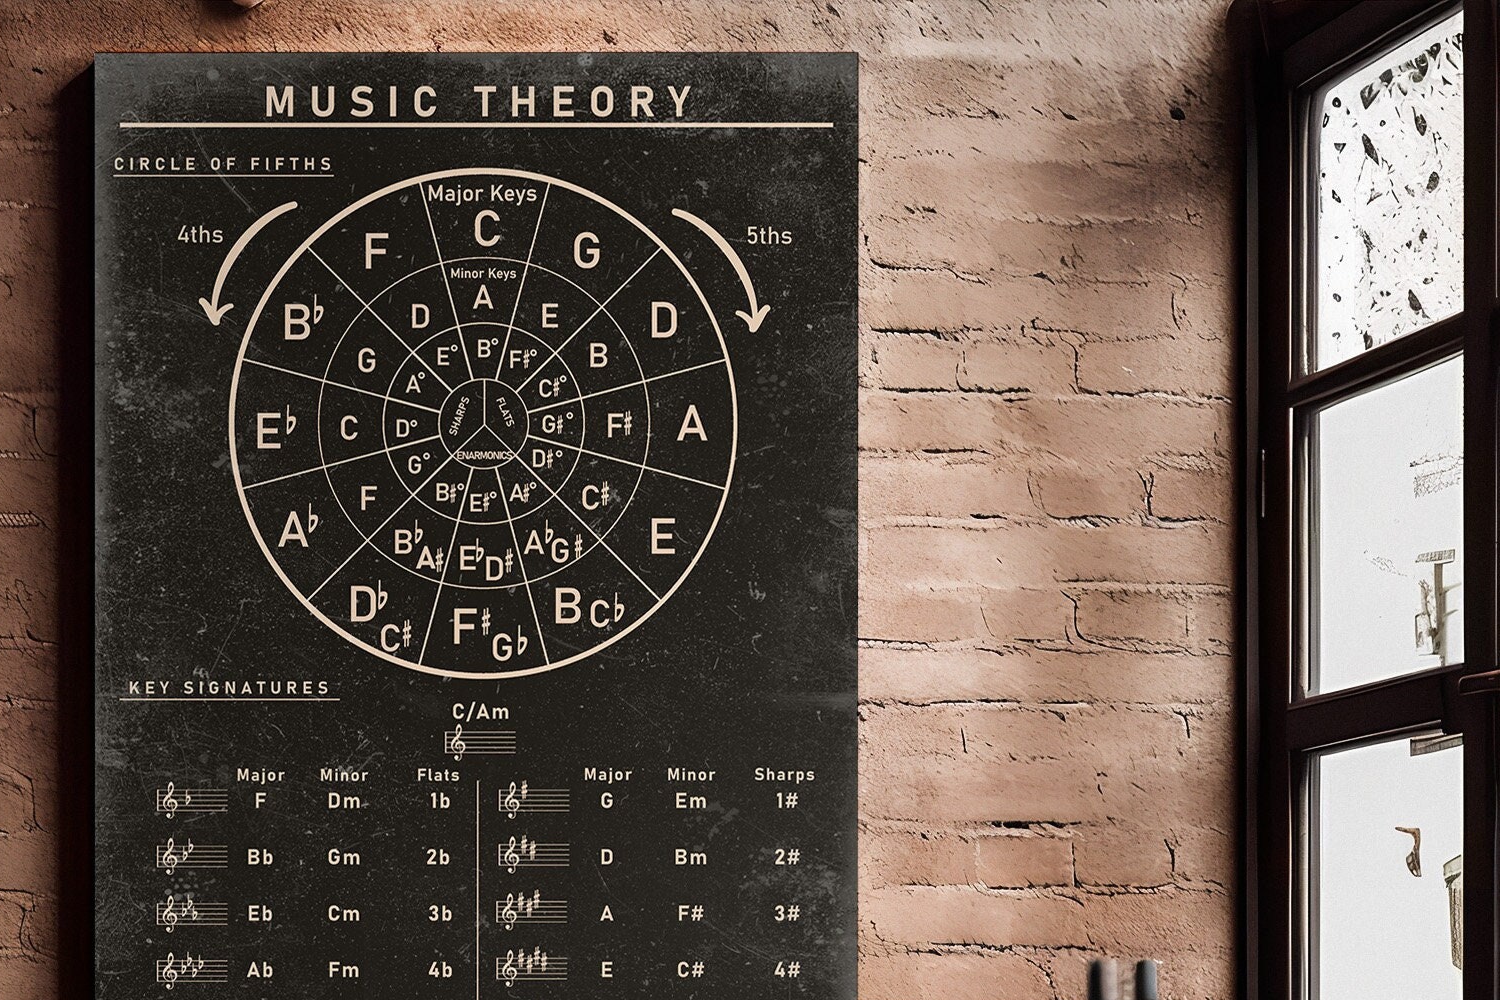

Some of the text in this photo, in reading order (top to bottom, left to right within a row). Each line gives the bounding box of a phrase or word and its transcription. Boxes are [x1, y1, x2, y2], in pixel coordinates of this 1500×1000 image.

[267, 86, 691, 117] MUSIC THEORY
[114, 157, 330, 170] CIRCLE OF FIFTHS
[429, 186, 537, 205] Major Keys
[178, 225, 223, 242] 4ths
[475, 210, 500, 246] C
[748, 227, 792, 244] 5ths
[366, 233, 388, 269] F
[574, 232, 599, 268] G
[451, 268, 516, 281] Minor Keys
[473, 285, 493, 309] A
[412, 304, 429, 328] D
[542, 303, 558, 328] E
[652, 302, 677, 338] D
[358, 348, 375, 372] G
[590, 343, 607, 367] B
[449, 396, 469, 436] SHARPS
[496, 397, 515, 427] FLATS
[677, 405, 707, 441] A
[341, 416, 357, 440] C
[361, 486, 377, 510] F
[652, 518, 675, 554] E
[556, 588, 581, 623] B
[130, 681, 327, 694] KEY SIGNATURES
[453, 702, 508, 722] C/Am
[238, 768, 459, 784] Major Minor Flats
[585, 768, 814, 784] Major Minor Sharps
[256, 793, 450, 808] F Dm 1b
[601, 793, 798, 808] G Em 1#
[248, 849, 449, 865] Bb Gm 2b
[602, 849, 800, 864] D Bm 2#
[249, 905, 452, 921] Eb Cm 3b
[601, 905, 800, 921] A F# 3#
[247, 962, 452, 977] Ab Fm 4b
[602, 962, 800, 977] E C# 4#
